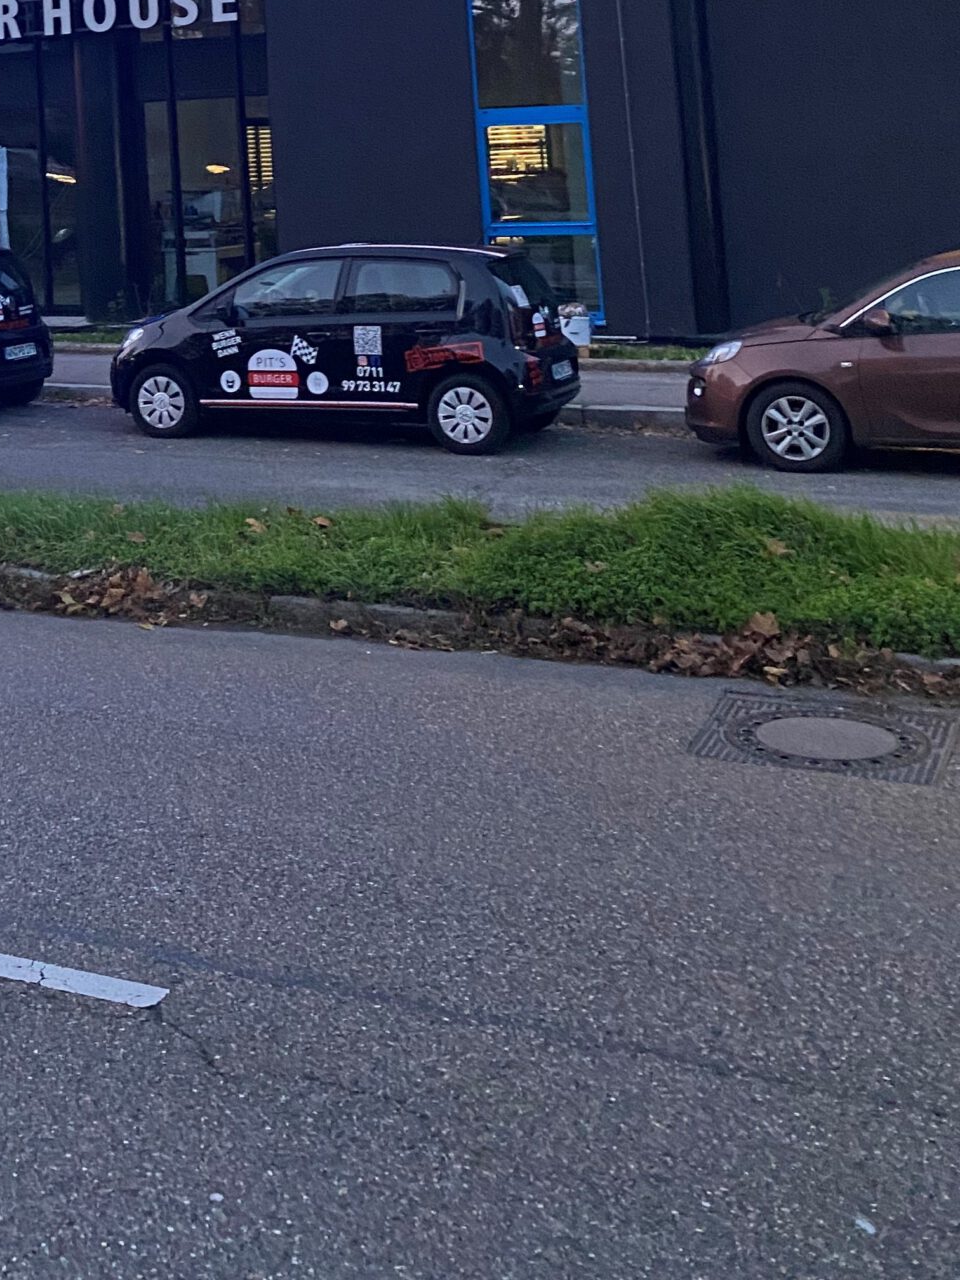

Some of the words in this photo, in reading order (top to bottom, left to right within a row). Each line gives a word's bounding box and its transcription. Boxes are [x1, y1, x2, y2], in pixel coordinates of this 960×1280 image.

[211, 336, 242, 350] BURGER
[256, 357, 286, 368] PIT'S
[356, 366, 383, 377] 0711
[252, 373, 293, 384] BURGER
